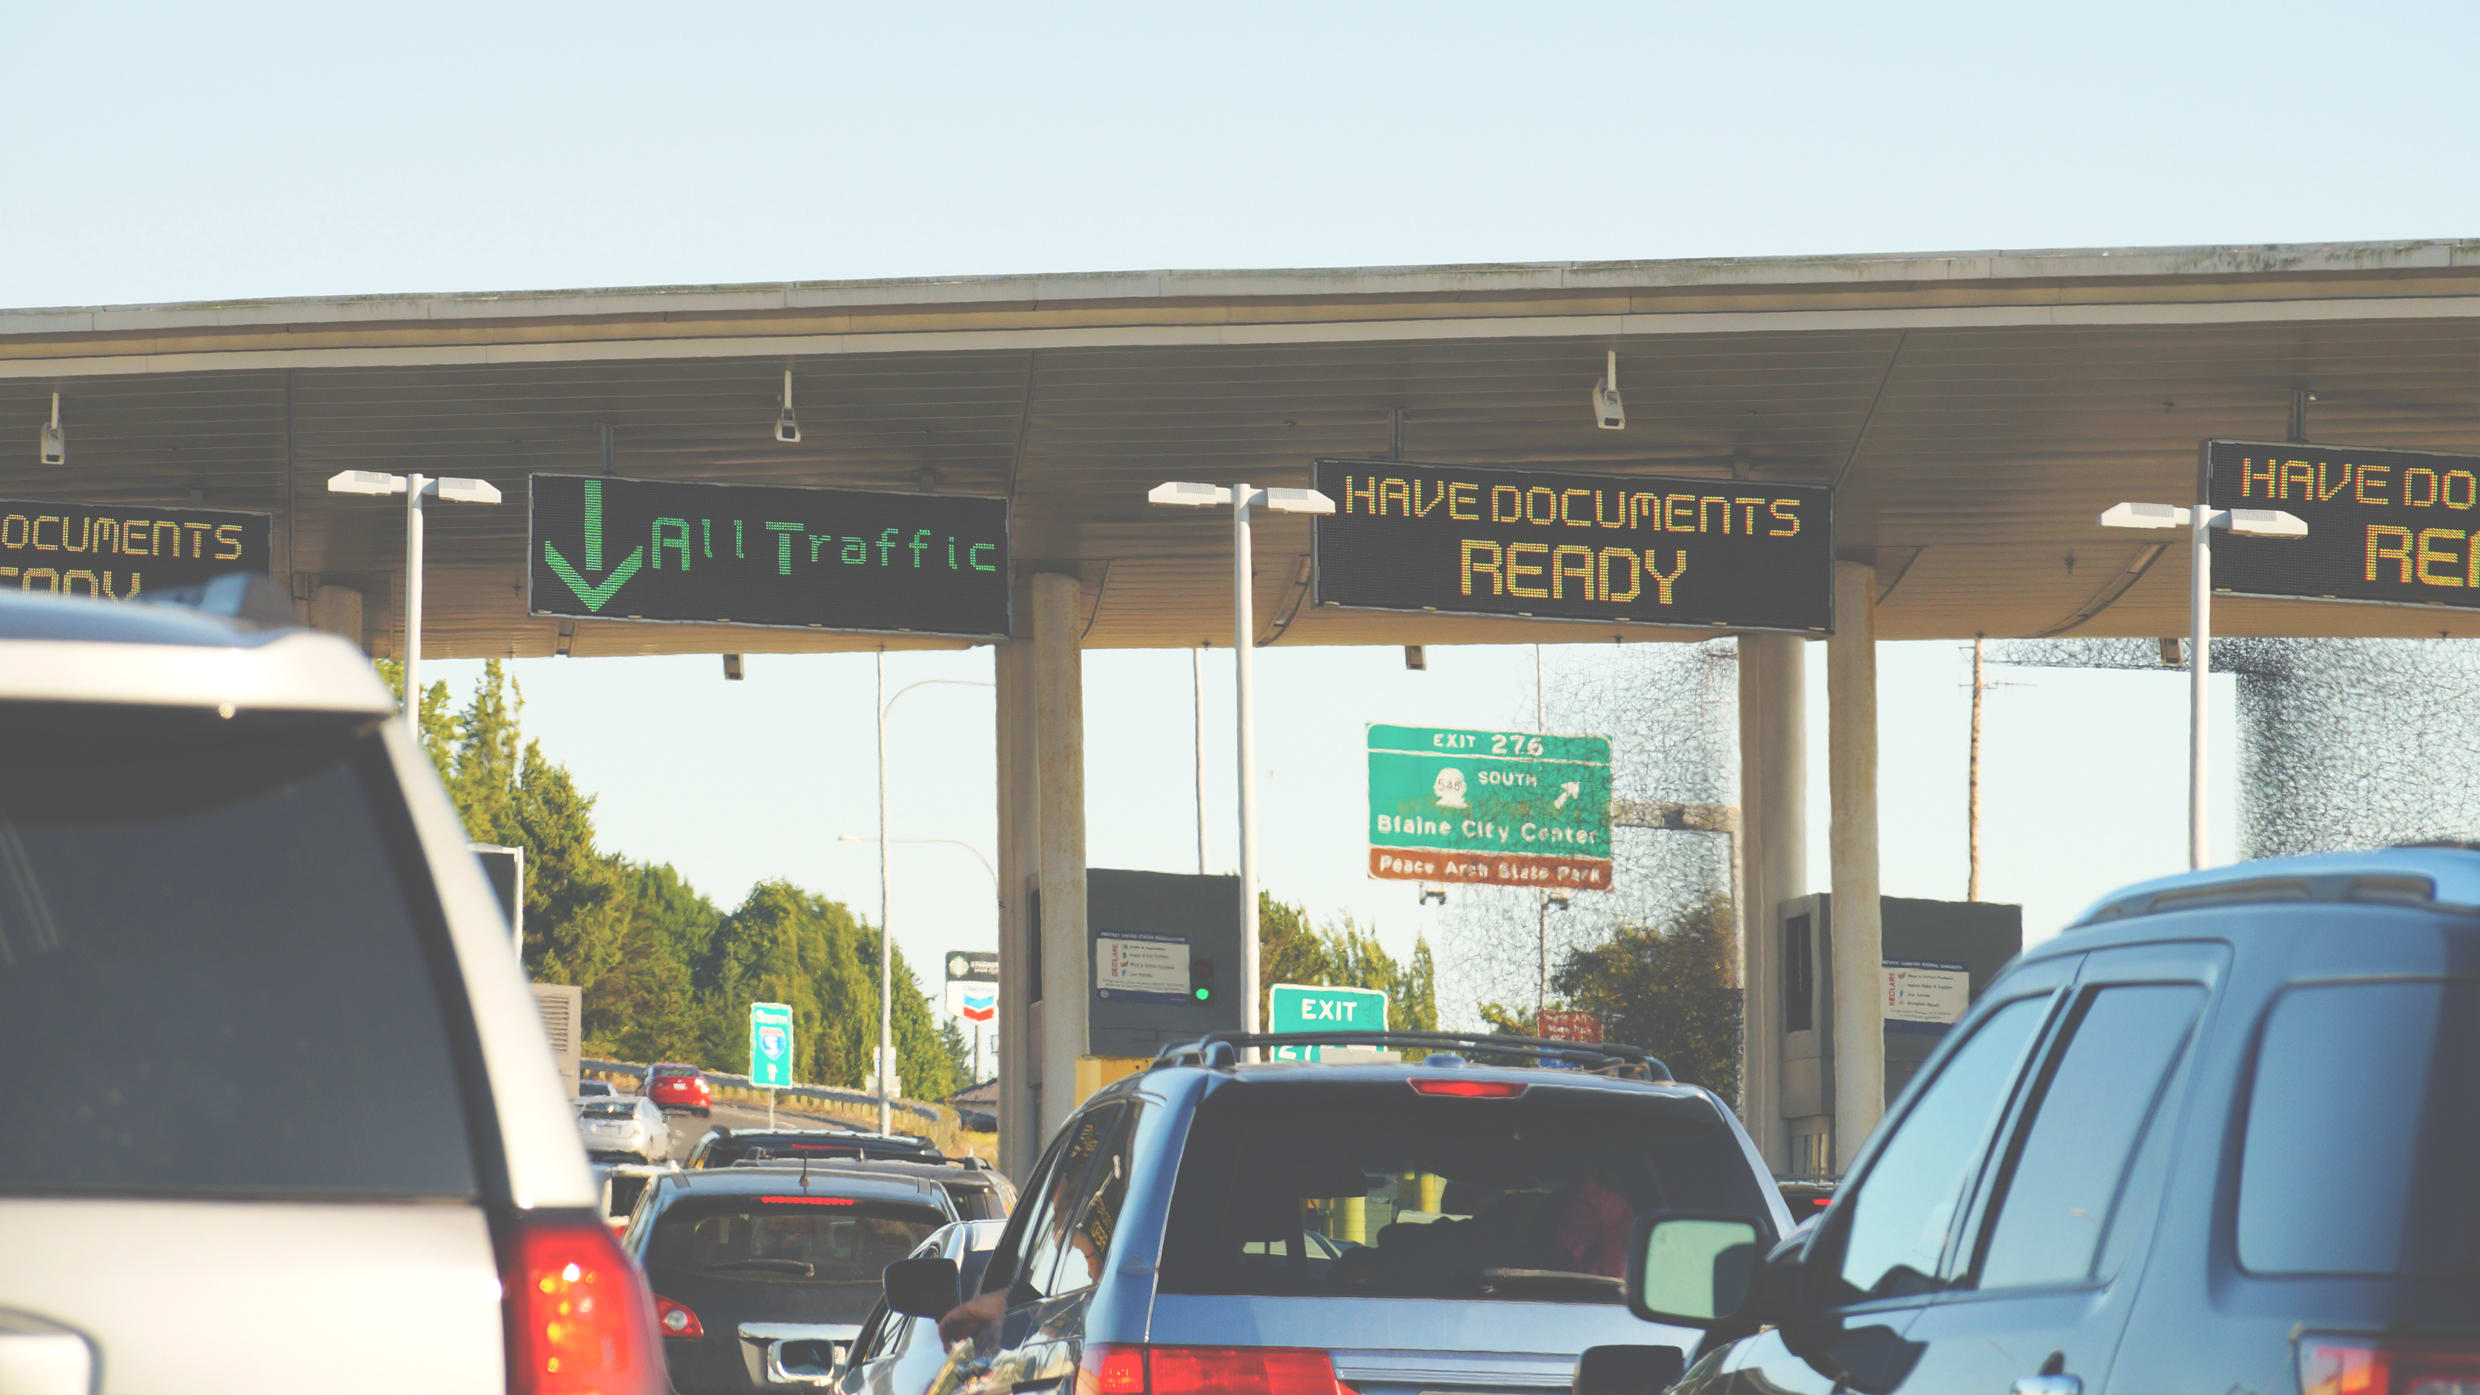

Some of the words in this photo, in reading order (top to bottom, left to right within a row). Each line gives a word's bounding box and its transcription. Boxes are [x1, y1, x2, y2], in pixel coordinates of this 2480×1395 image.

[2241, 458, 2391, 505] HAVE
[2403, 467, 2477, 510] DO
[1346, 475, 1480, 520] HAVE
[1492, 484, 1801, 537] DOCUMENTS
[1, 514, 243, 560] OCUMENTS
[651, 517, 745, 572] All
[765, 520, 997, 576] Traffic
[1461, 538, 1687, 604] READY
[1433, 733, 1476, 749] EXIT
[1491, 734, 1545, 757] 276
[1478, 770, 1538, 788] SOUTH
[1377, 814, 1452, 835] Blaine
[1461, 819, 1509, 844] City
[1521, 822, 1599, 844] Center
[1379, 854, 1435, 875] Peace
[1444, 860, 1488, 878] Arch
[1498, 862, 1550, 881] State
[1557, 865, 1601, 883] Park
[1301, 998, 1358, 1022] EXIT
